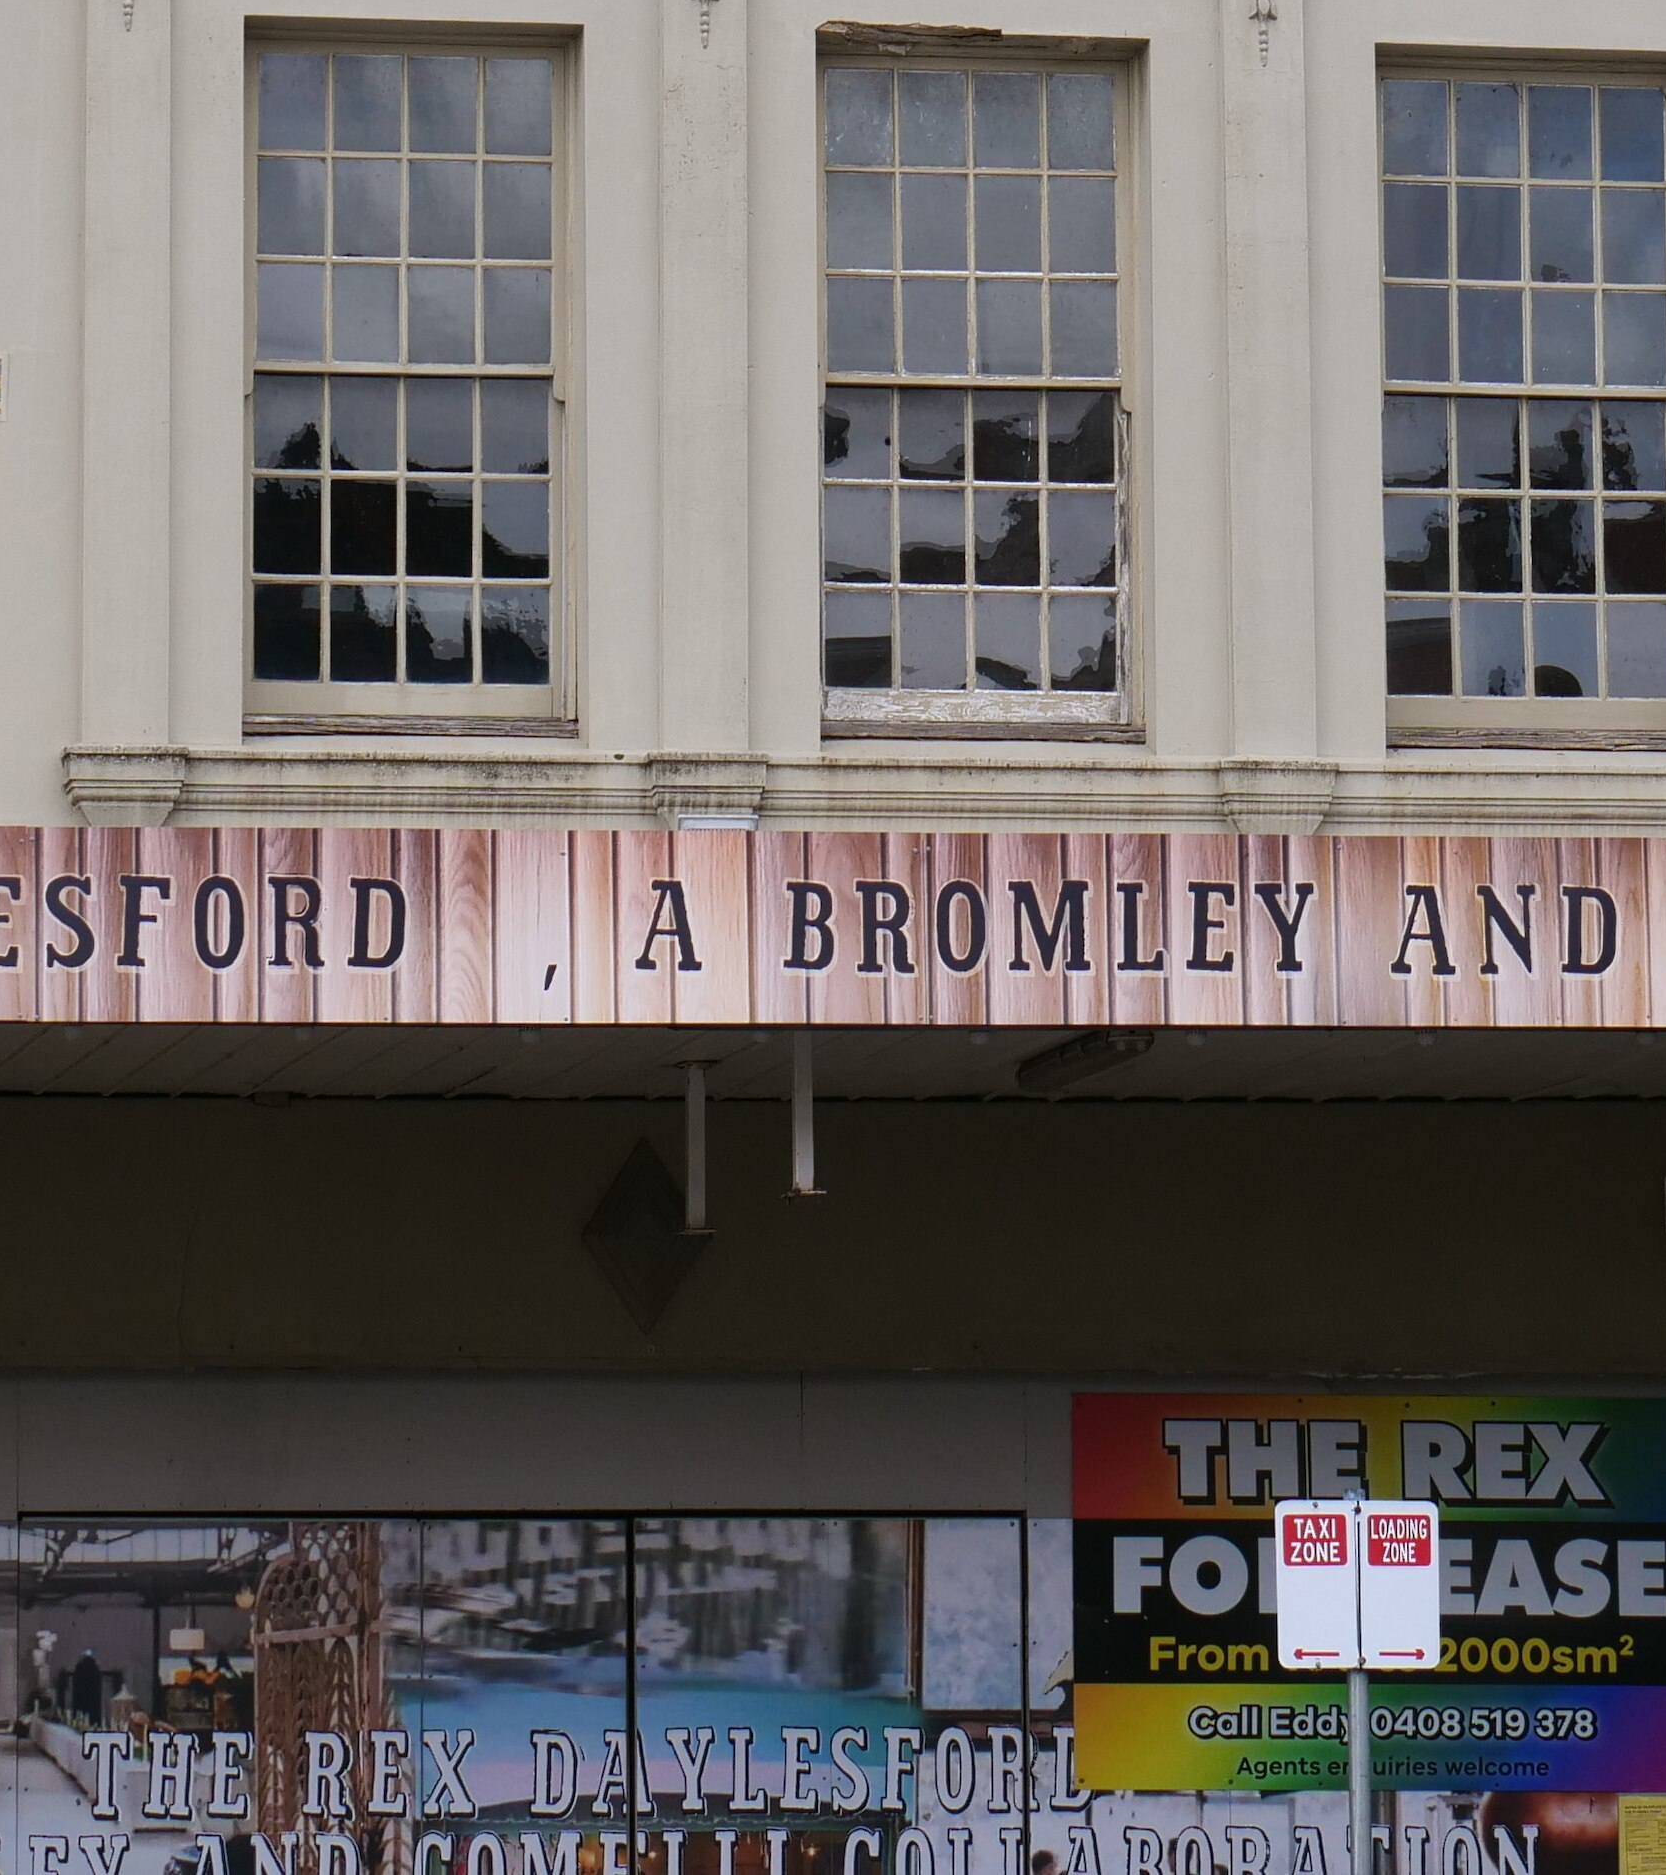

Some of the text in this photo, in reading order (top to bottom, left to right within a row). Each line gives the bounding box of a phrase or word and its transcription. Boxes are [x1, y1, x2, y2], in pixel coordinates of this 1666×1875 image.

[634, 878, 703, 973] A
[781, 879, 1315, 975] BROMLEY
[1388, 883, 1618, 977] AND
[1162, 1418, 1614, 1507] THE REX
[1294, 1517, 1337, 1540] TAXI
[1369, 1518, 1428, 1540] LOADING
[1289, 1541, 1341, 1564] ZONE
[1381, 1541, 1417, 1565] ZONE
[1148, 1635, 1270, 1672] From
[1189, 1705, 1260, 1739] Call
[1370, 1706, 1466, 1740] 0408
[1470, 1708, 1528, 1740] 519
[1535, 1708, 1597, 1741] 378
[80, 1729, 254, 1821] THE
[301, 1728, 477, 1822] REX
[1236, 1755, 1549, 1780] Agents enuiries welcome
